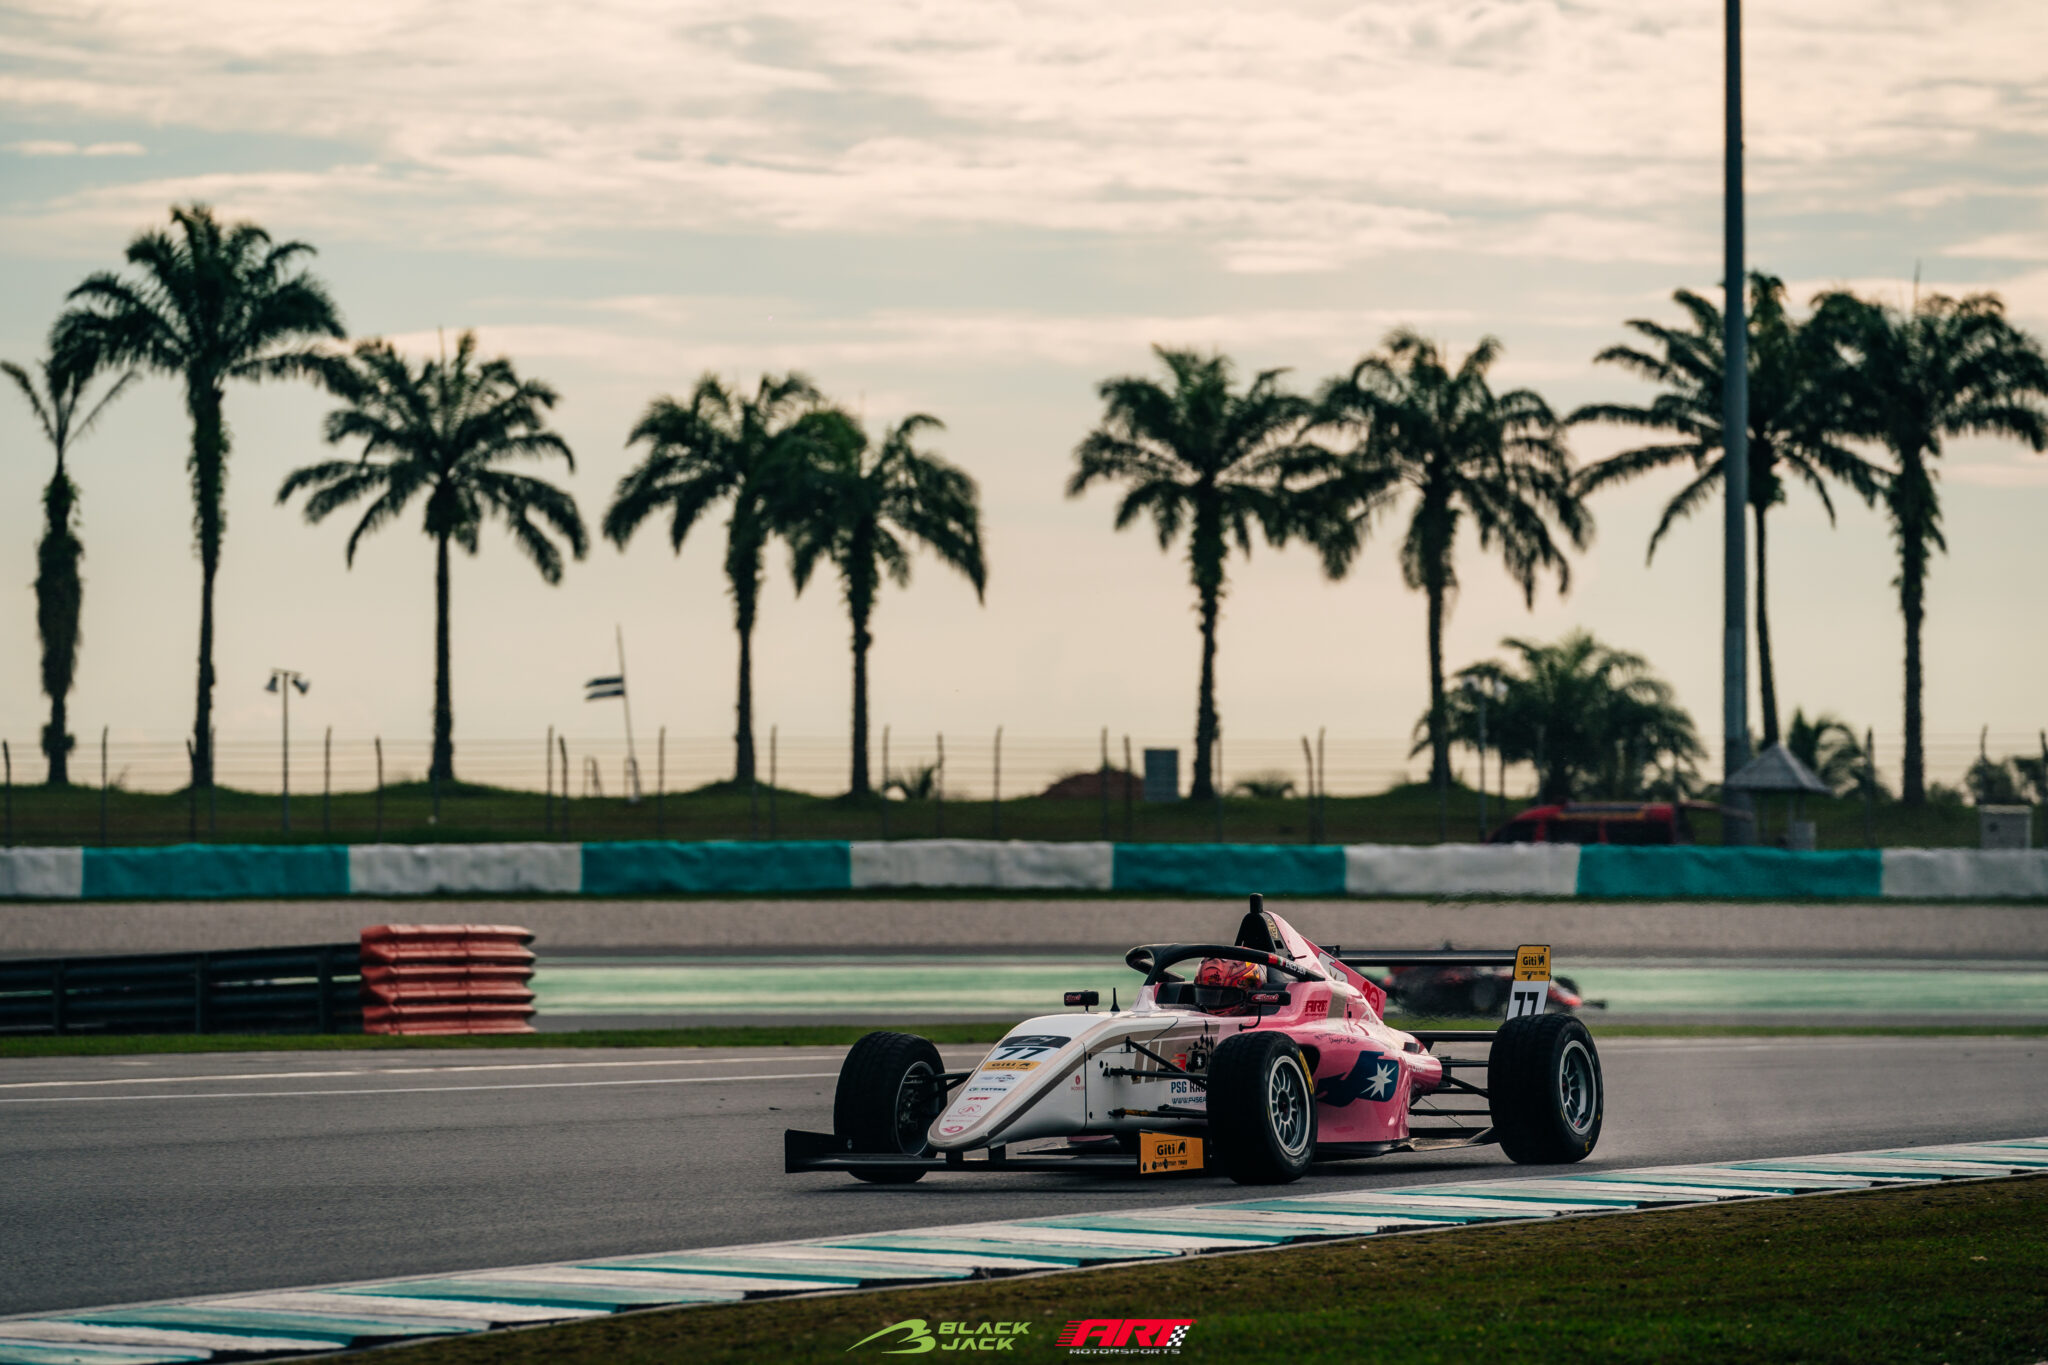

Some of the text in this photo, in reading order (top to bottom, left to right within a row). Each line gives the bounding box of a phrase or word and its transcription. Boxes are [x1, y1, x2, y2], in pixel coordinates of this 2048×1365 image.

[1522, 956, 1537, 966] Giti
[1514, 991, 1540, 1017] 77
[995, 1047, 1050, 1060] 77
[1170, 1081, 1187, 1093] PSG
[1156, 1143, 1176, 1156] Giti
